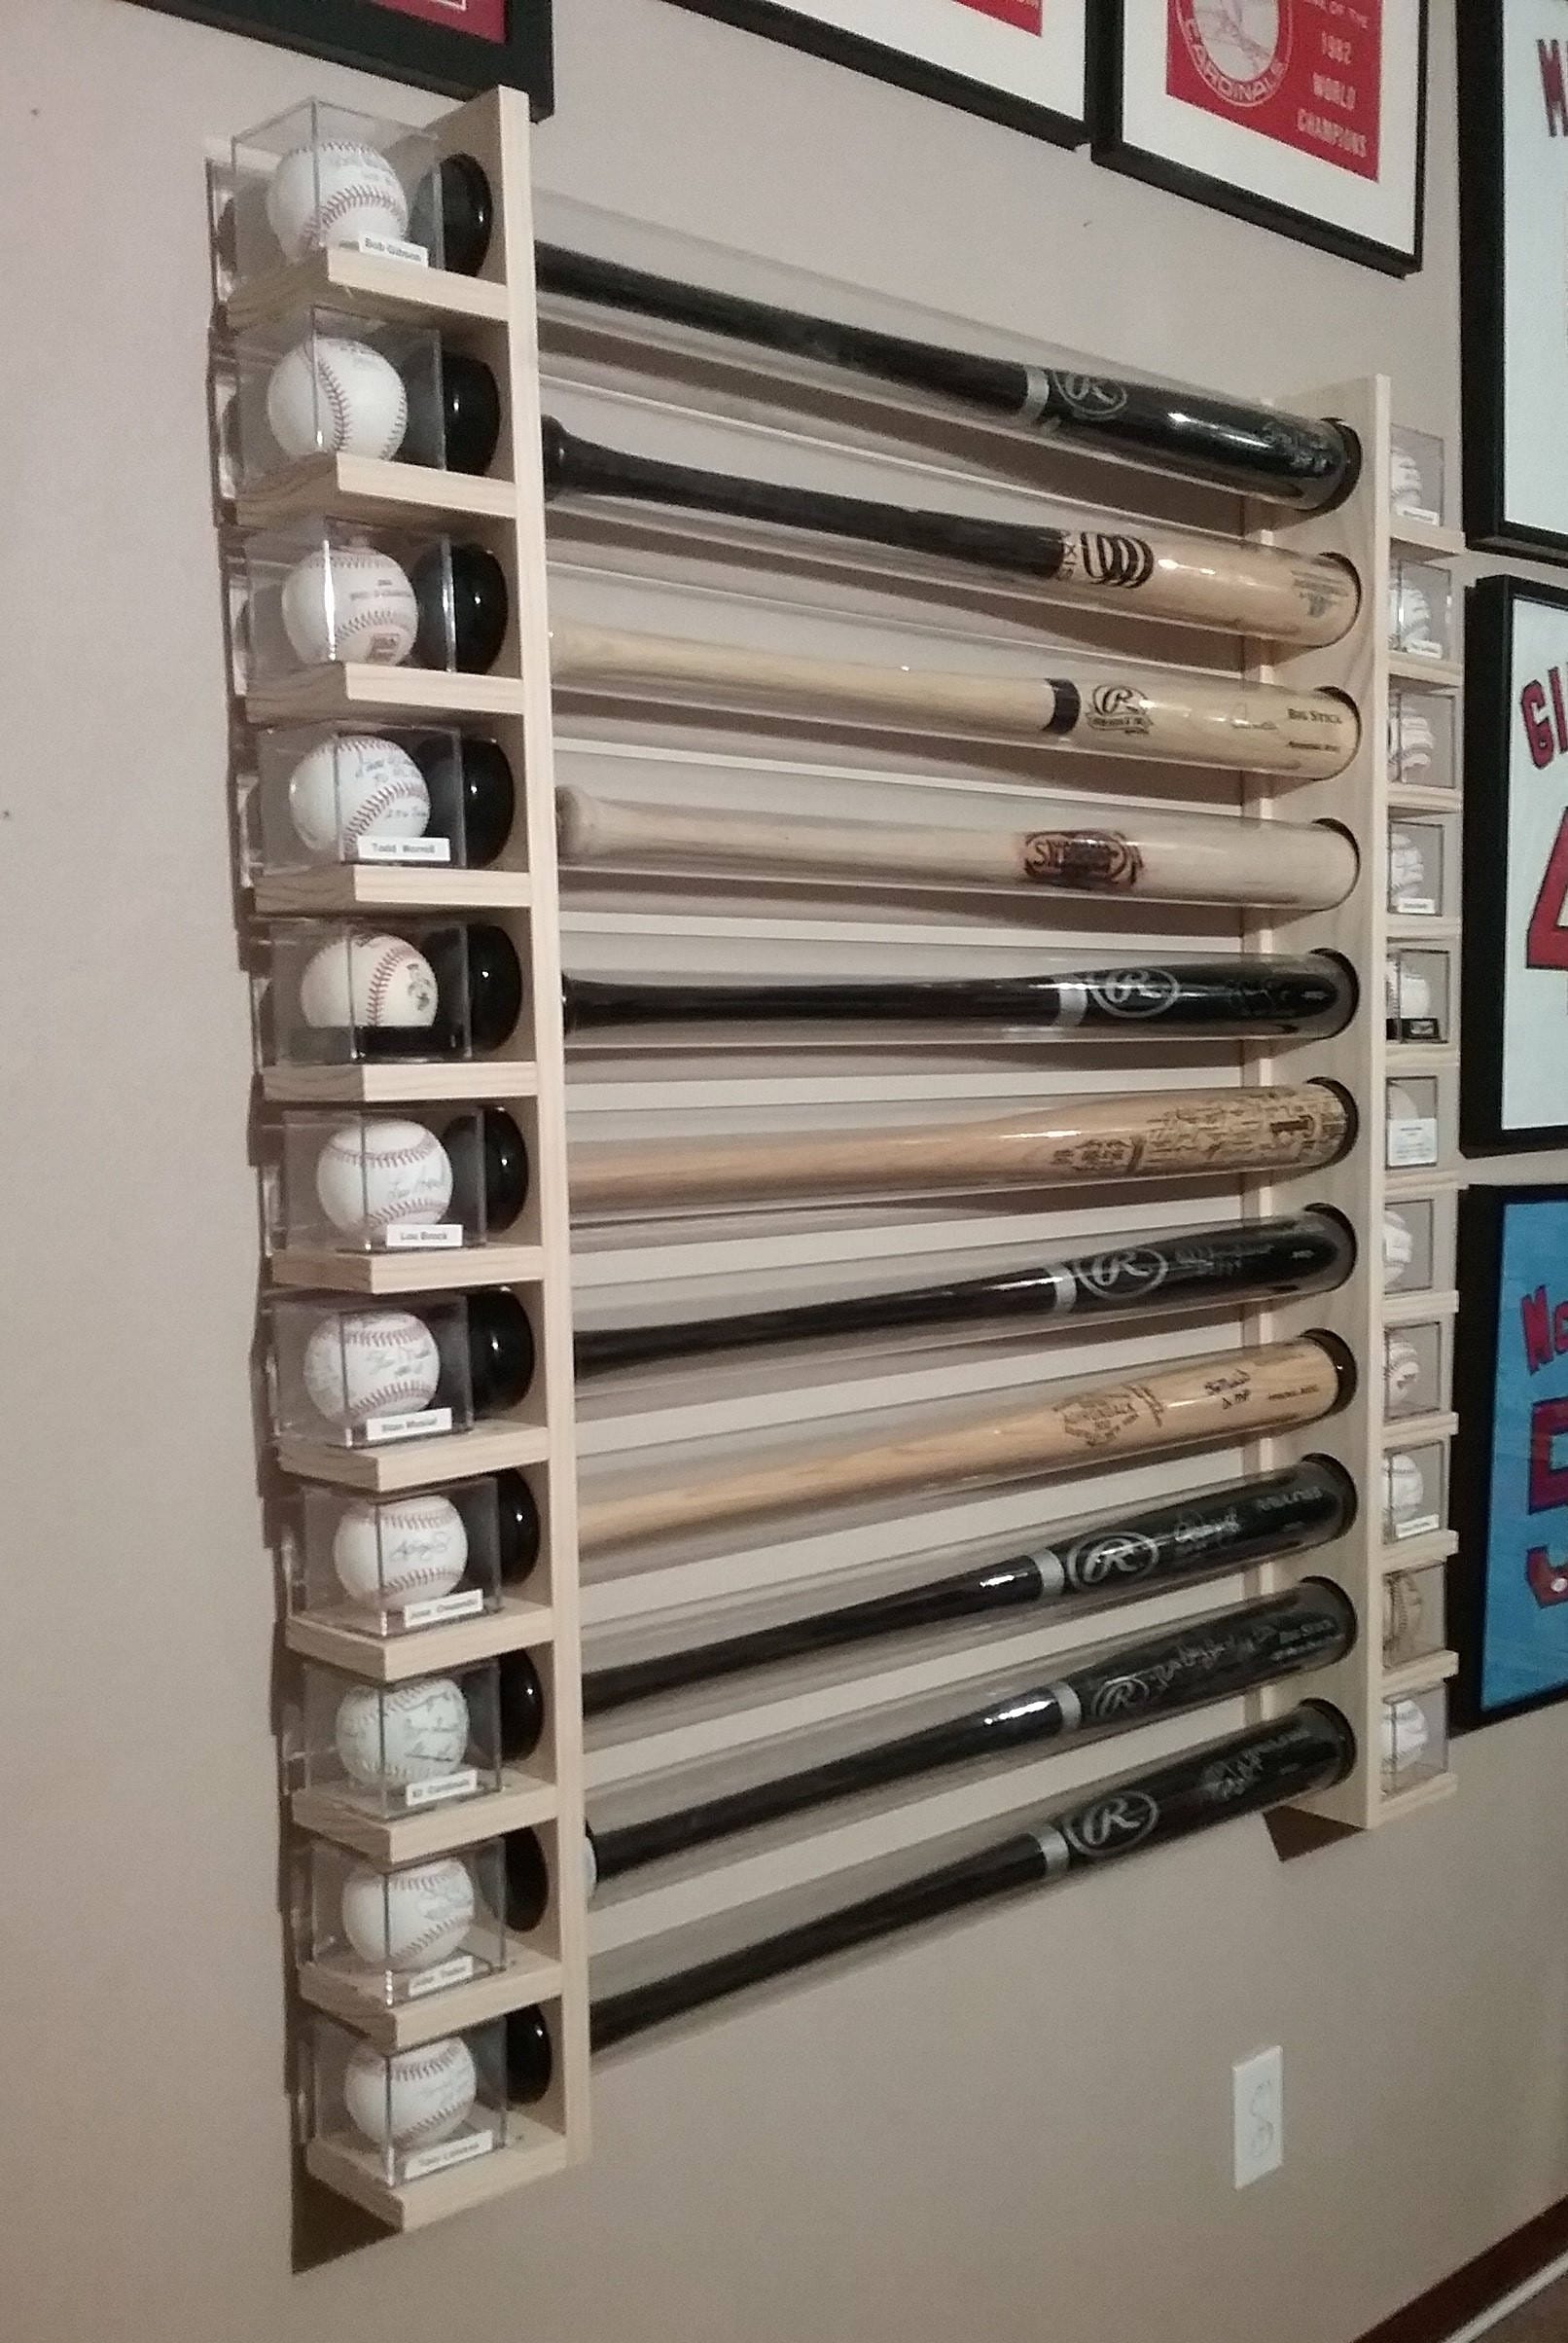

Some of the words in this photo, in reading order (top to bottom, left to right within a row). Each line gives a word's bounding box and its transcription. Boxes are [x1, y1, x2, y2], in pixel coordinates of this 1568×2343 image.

[1321, 30, 1351, 65] 1982
[1312, 71, 1356, 111] WORLD
[1298, 108, 1367, 158] CHAMPIONS
